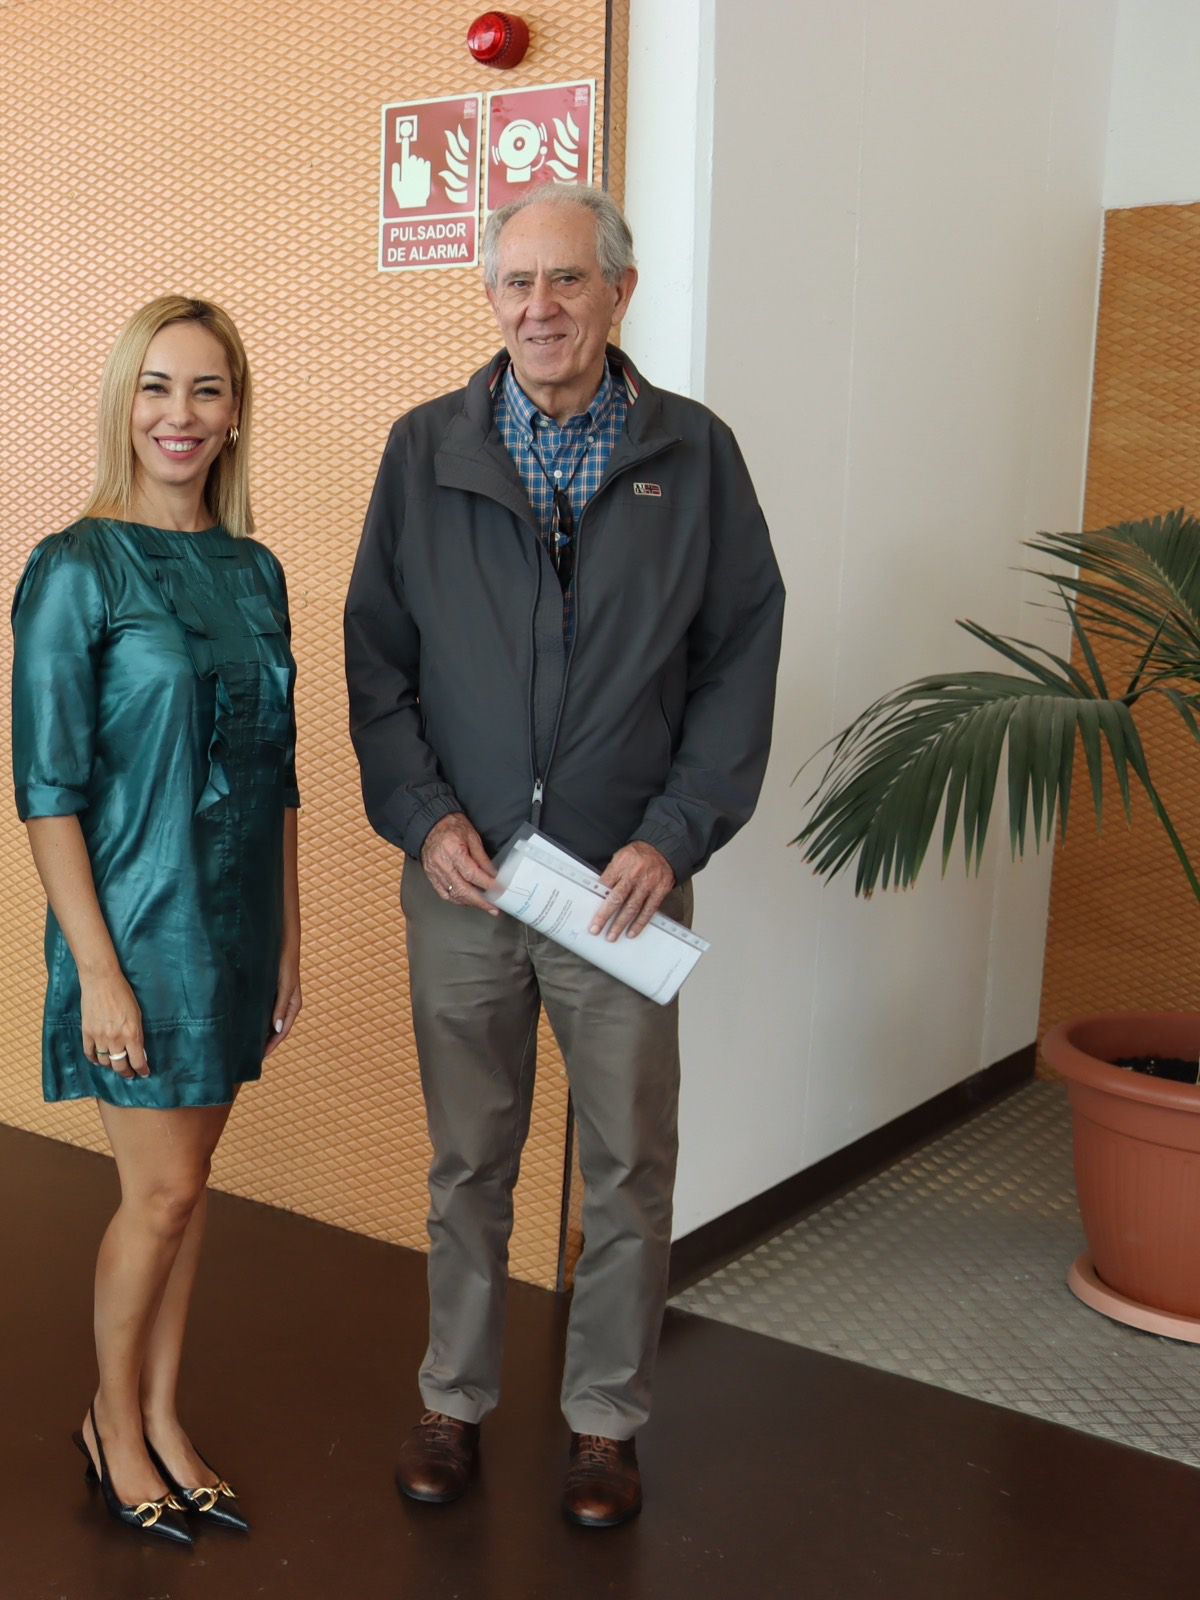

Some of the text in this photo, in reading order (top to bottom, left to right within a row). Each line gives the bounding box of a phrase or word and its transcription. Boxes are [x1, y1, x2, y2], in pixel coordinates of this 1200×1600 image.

[390, 222, 466, 242] PULSADOR
[387, 243, 468, 262] DE ALARMA
